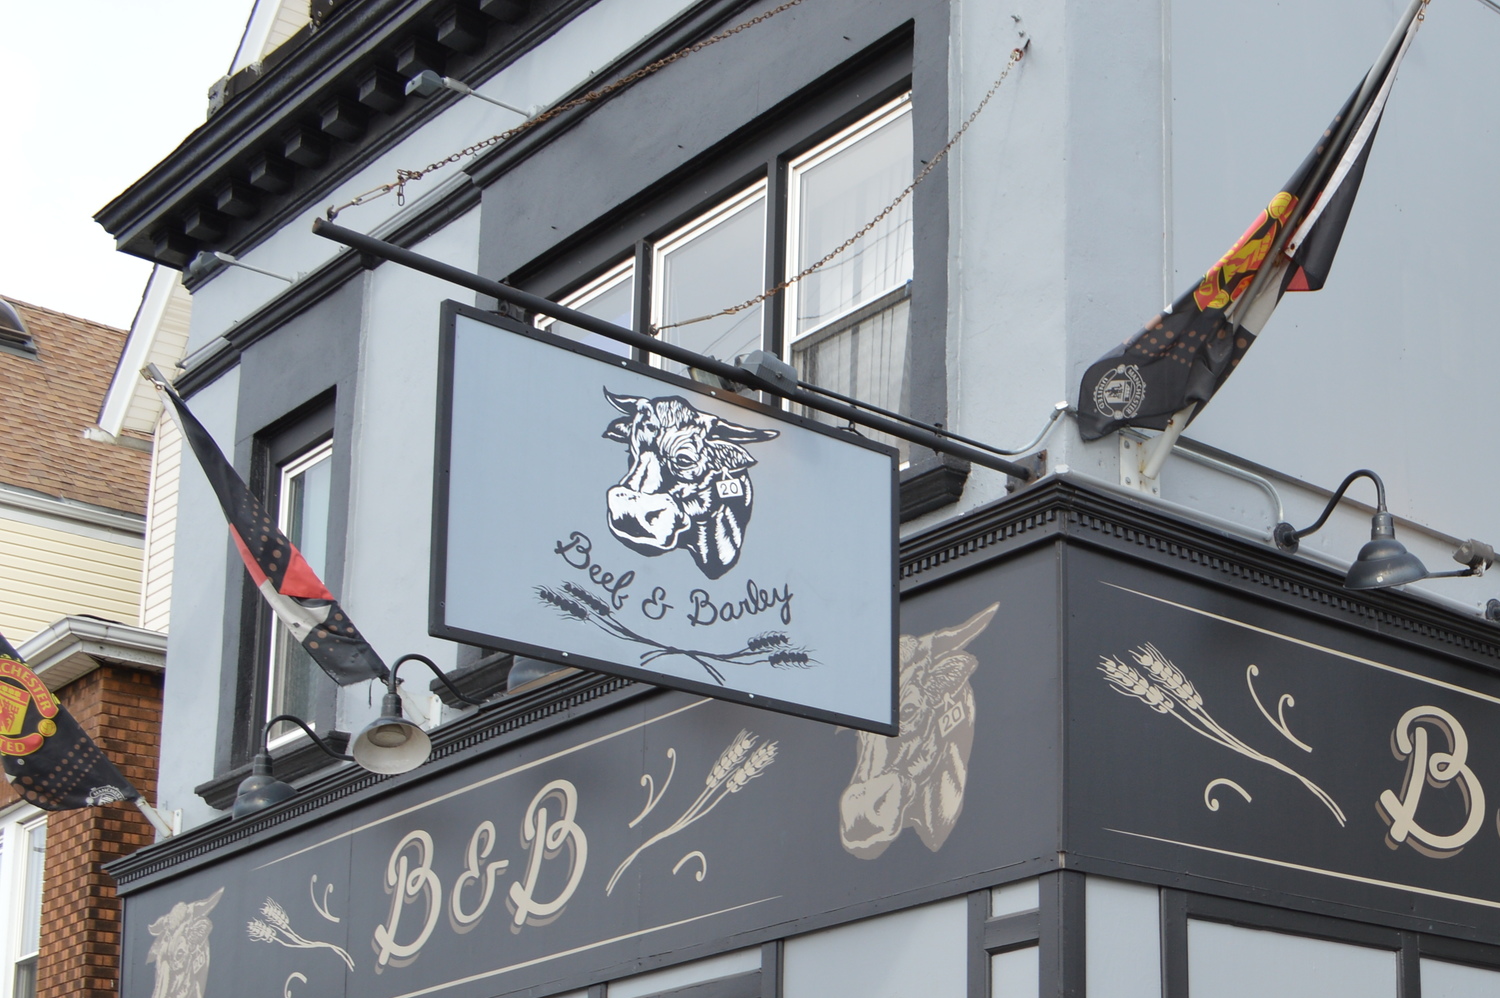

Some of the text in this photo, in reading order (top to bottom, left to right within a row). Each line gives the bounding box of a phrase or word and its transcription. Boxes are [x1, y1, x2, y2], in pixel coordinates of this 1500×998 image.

[1096, 377, 1109, 409] UNITED
[1125, 368, 1142, 414] MANCHESTER
[720, 482, 738, 495] 20
[554, 531, 794, 626] Beef & Barley
[0, 662, 52, 711] CHESTER
[943, 706, 962, 732] 20
[0, 739, 26, 753] TED
